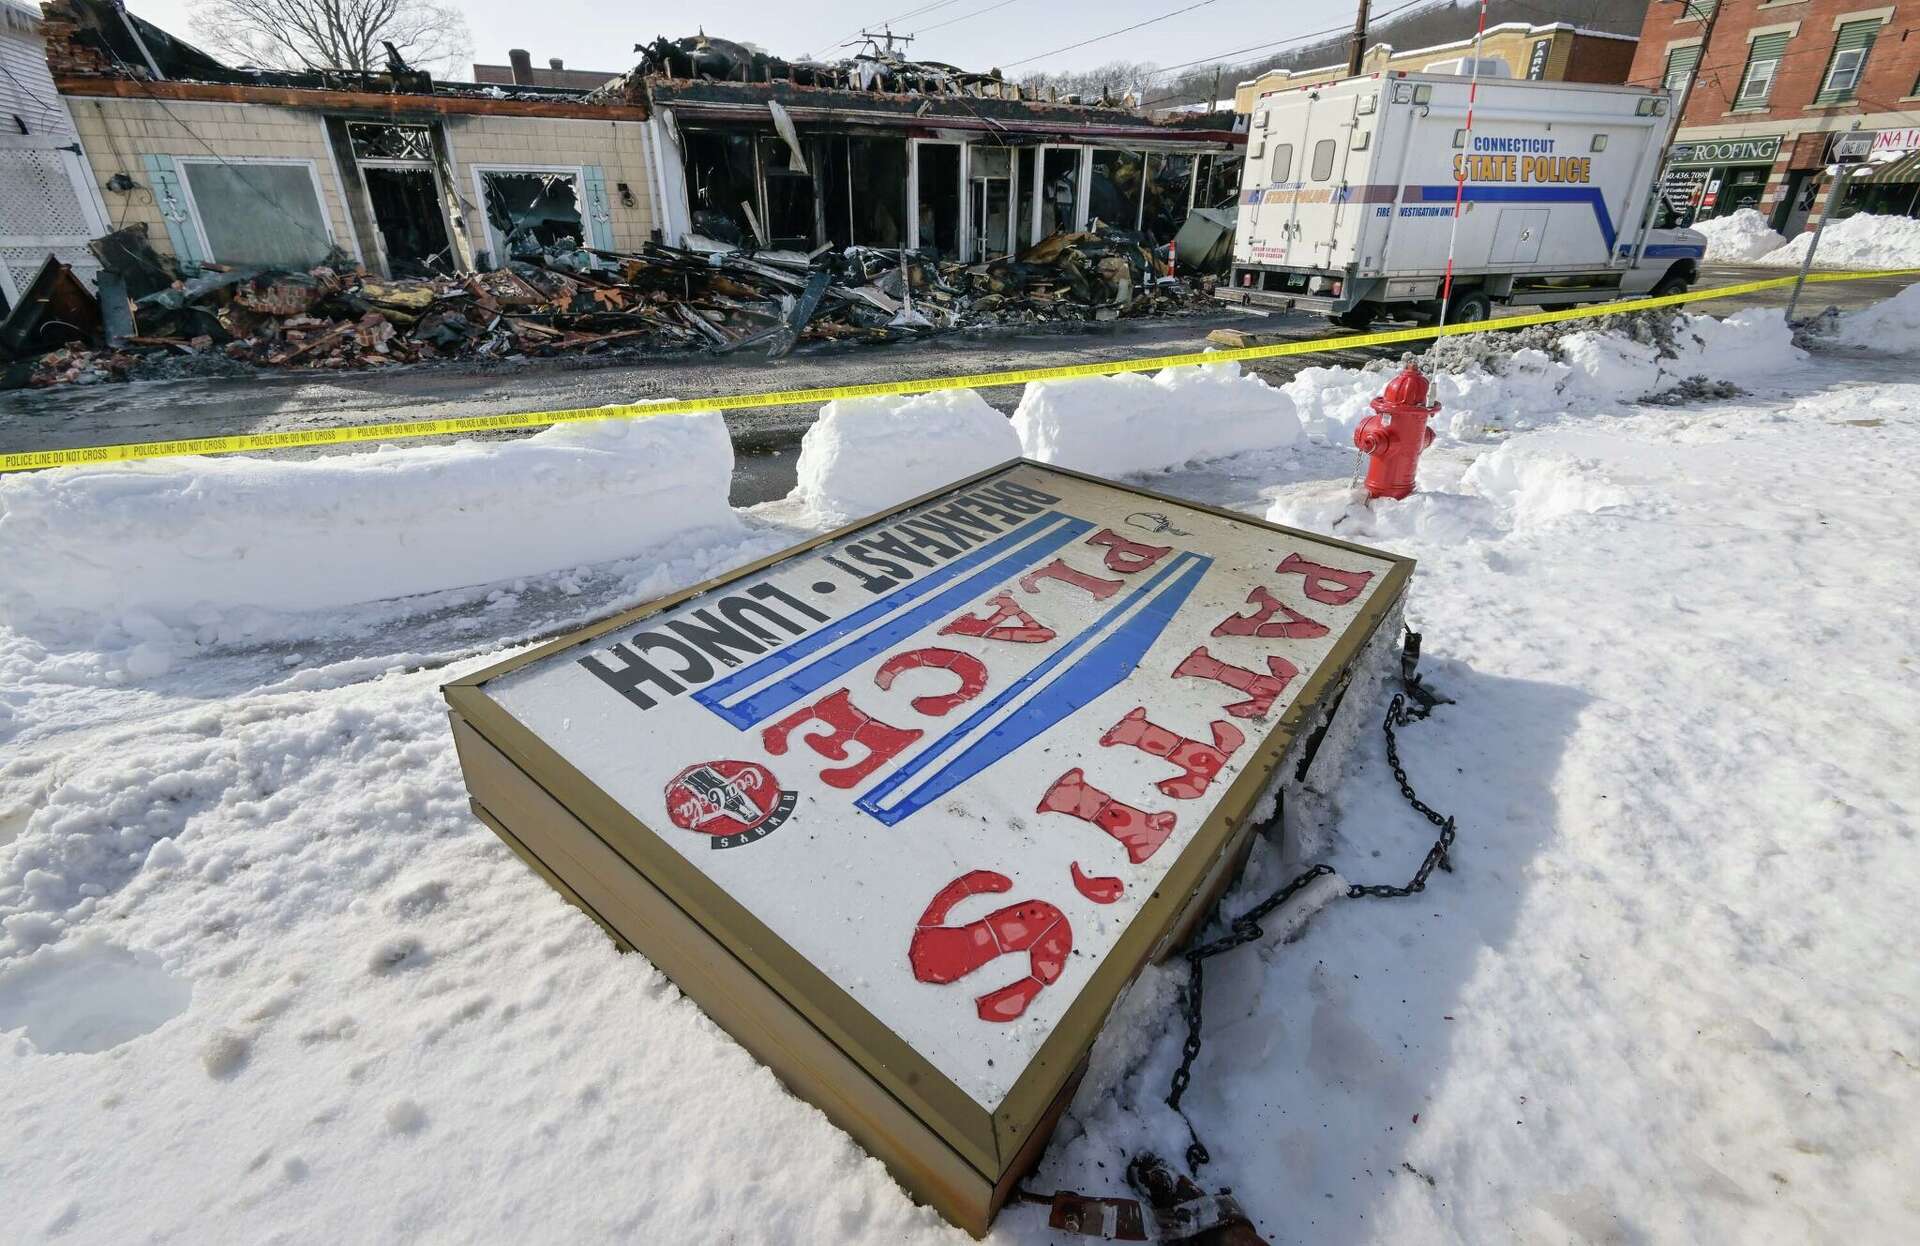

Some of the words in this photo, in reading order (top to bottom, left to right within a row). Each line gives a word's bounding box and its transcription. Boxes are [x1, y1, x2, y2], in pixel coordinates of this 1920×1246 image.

[1474, 137, 1555, 152] CONNECTICUT
[1694, 141, 1774, 160] ROOFING
[1453, 154, 1517, 182] STATE
[1522, 156, 1591, 183] POLICE
[1376, 207, 1390, 217] FIRE
[1440, 207, 1454, 217] UNIT
[250, 436, 273, 446] POLICE
[275, 434, 288, 444] LINE
[290, 433, 299, 442] DO
[301, 432, 313, 441] NOT
[315, 430, 336, 440] CROSS
[358, 427, 378, 437] POLICE
[380, 426, 393, 435] LINE
[394, 425, 402, 434] DO
[404, 424, 415, 432] NOT
[417, 422, 436, 432] CROSS
[134, 444, 160, 456] POLICE
[160, 443, 176, 454] LINE
[177, 442, 187, 452] DO
[188, 441, 202, 451] NOT
[205, 440, 227, 450] CROSS
[6, 454, 32, 467] POLICE
[34, 453, 51, 464] LINE
[53, 452, 64, 463] DO
[66, 451, 80, 462] NOT
[82, 449, 107, 460] CROSS
[822, 479, 1063, 595] BREAKFAST
[576, 582, 831, 711] LUNCH
[761, 528, 1172, 789] PLACE
[908, 552, 1376, 1022] PATTI'S
[721, 795, 795, 847] ALWAYS
